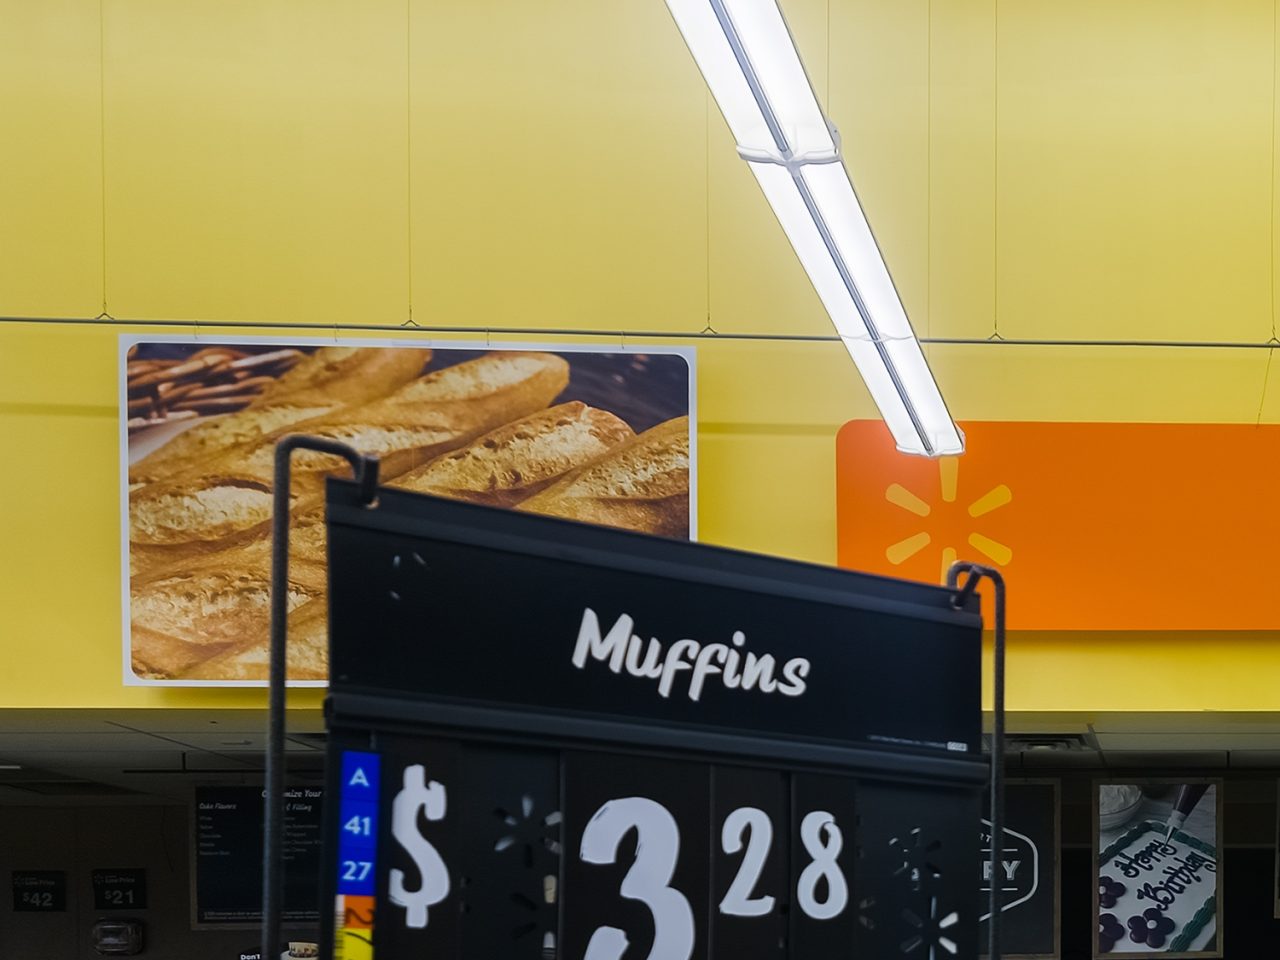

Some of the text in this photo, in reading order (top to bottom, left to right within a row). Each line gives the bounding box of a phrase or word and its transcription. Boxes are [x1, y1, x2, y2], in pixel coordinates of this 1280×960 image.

[571, 606, 811, 701] Muffins
[348, 766, 370, 788] A
[343, 815, 371, 836] 41
[1114, 839, 1177, 878] Happy
[341, 860, 373, 881] 27
[1137, 851, 1217, 911] Birthday
[23, 891, 54, 907] $42
[104, 889, 135, 904] $21
